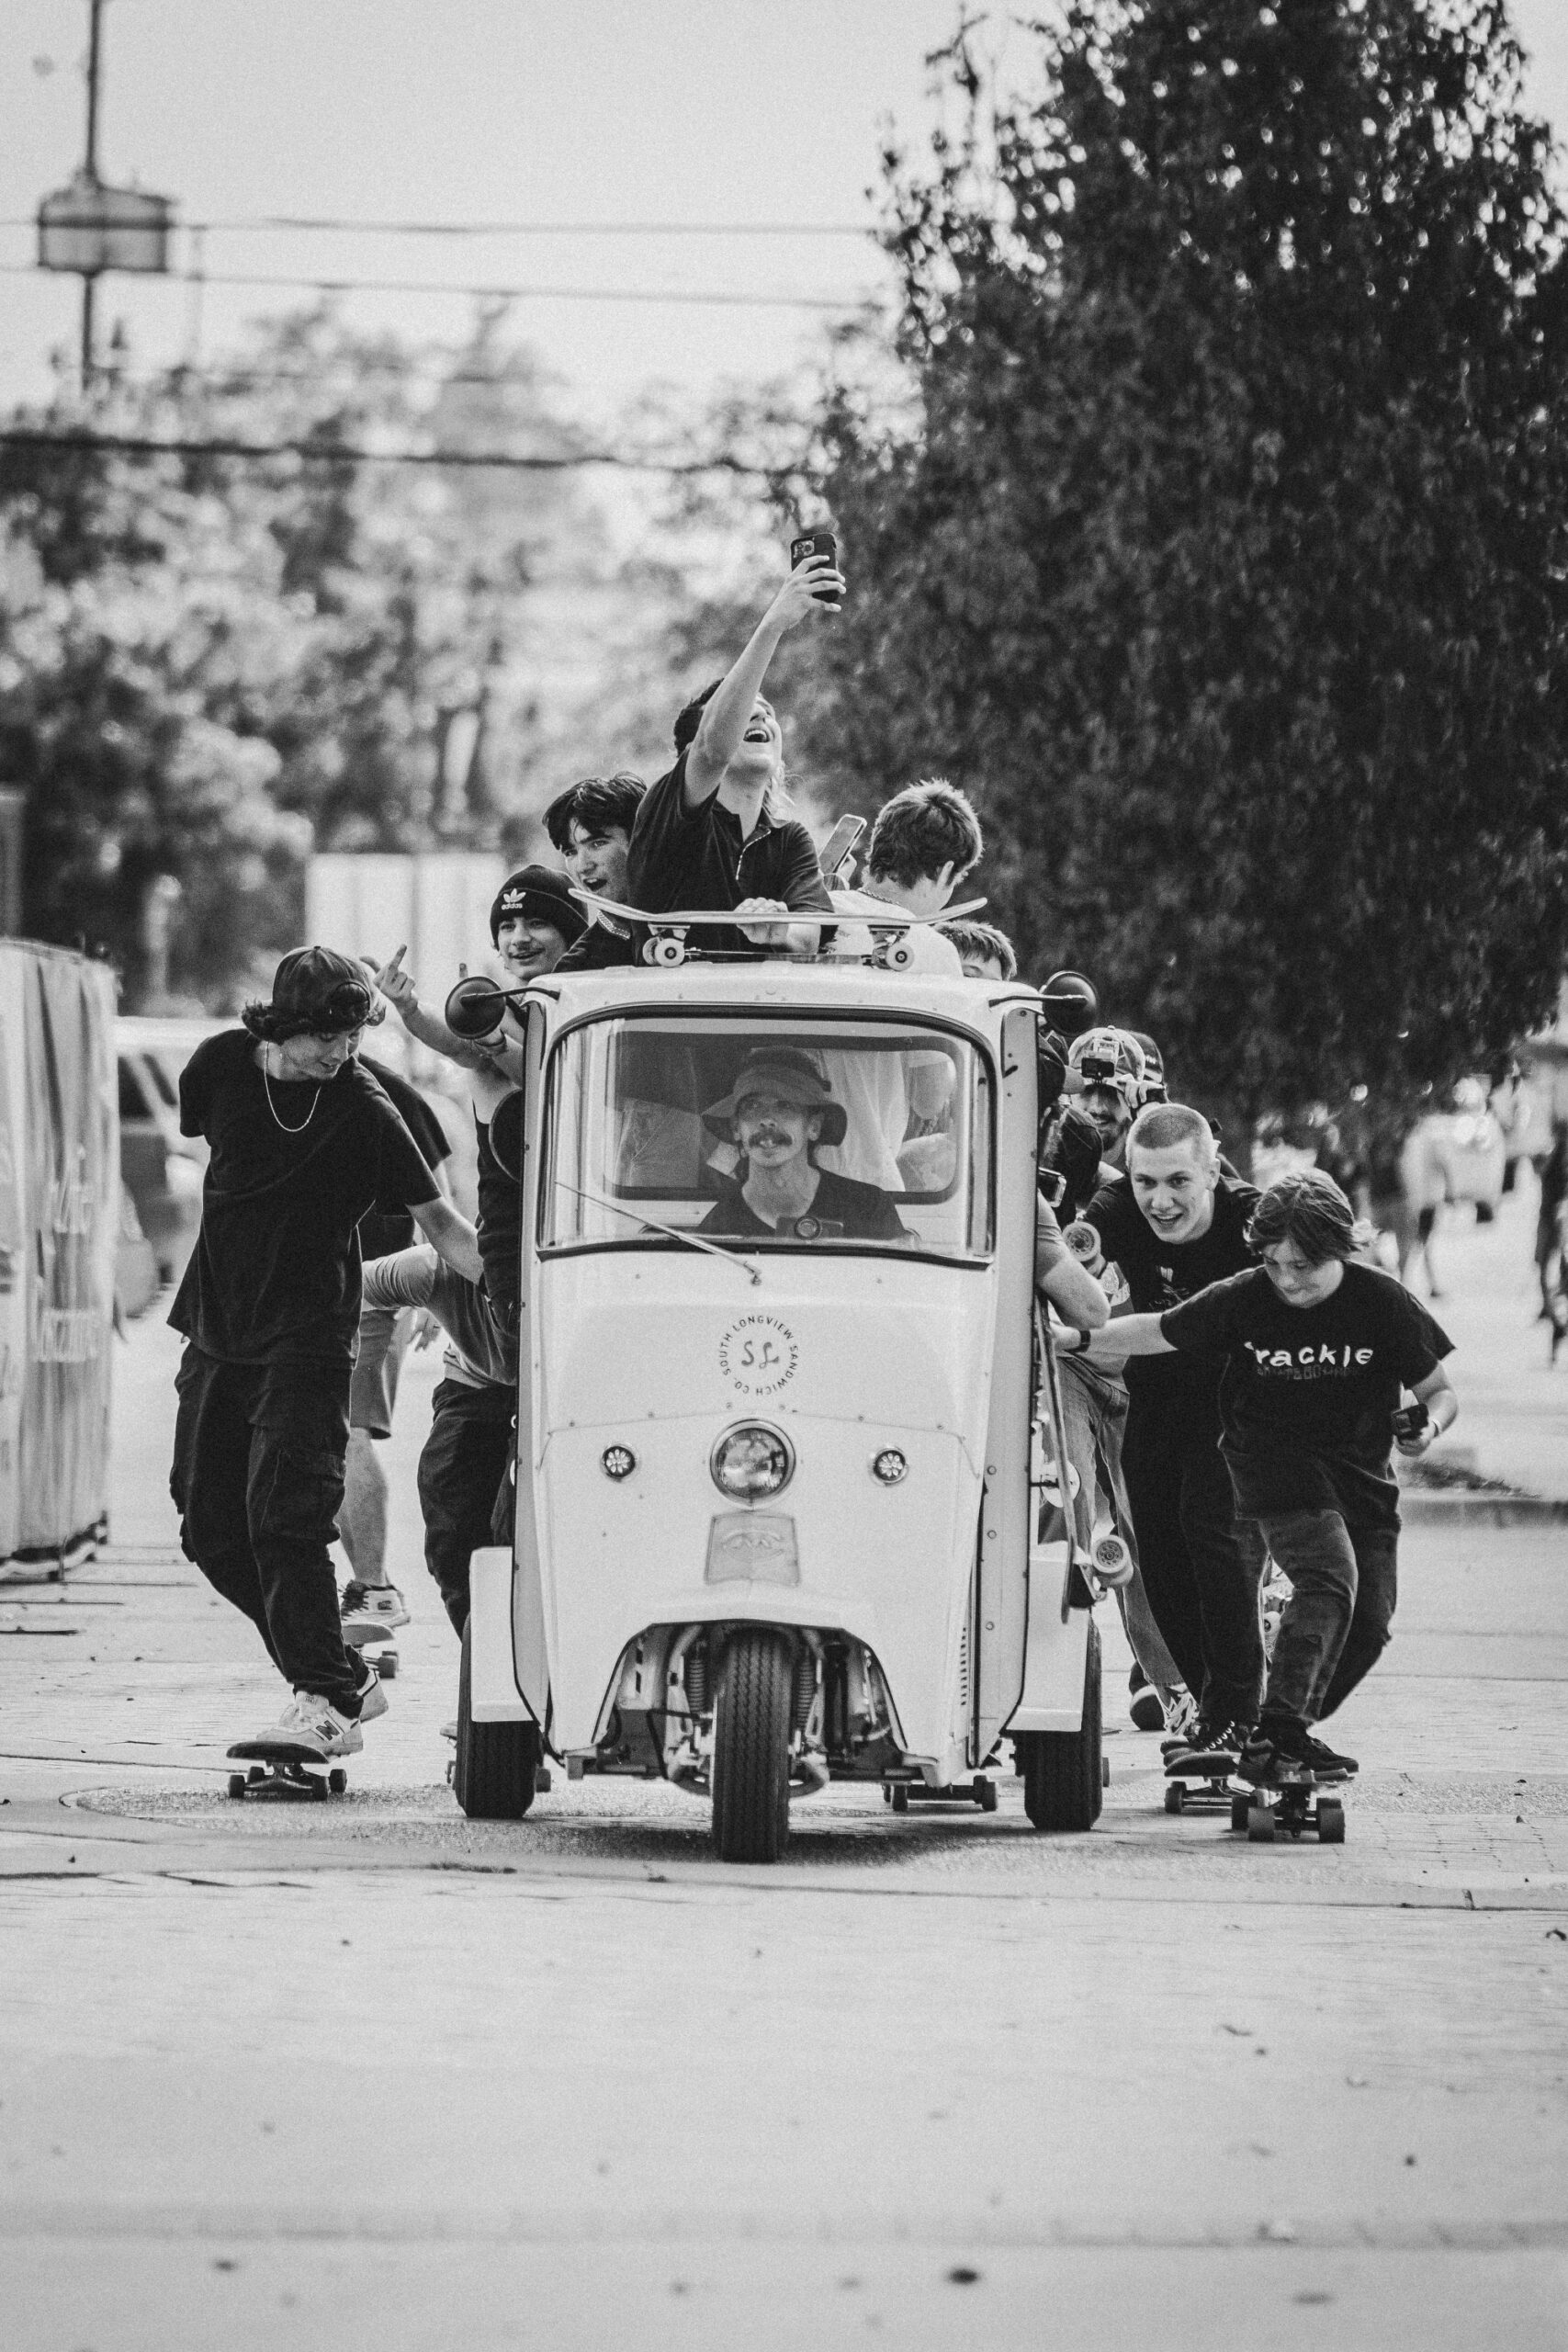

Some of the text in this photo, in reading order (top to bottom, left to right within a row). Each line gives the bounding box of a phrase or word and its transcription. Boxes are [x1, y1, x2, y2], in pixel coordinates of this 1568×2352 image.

[732, 1316, 794, 1340] LONGVIEW
[719, 1333, 733, 1376] SOUTH
[756, 1345, 799, 1396] SANDWICH
[1244, 1341, 1373, 1367] rackle
